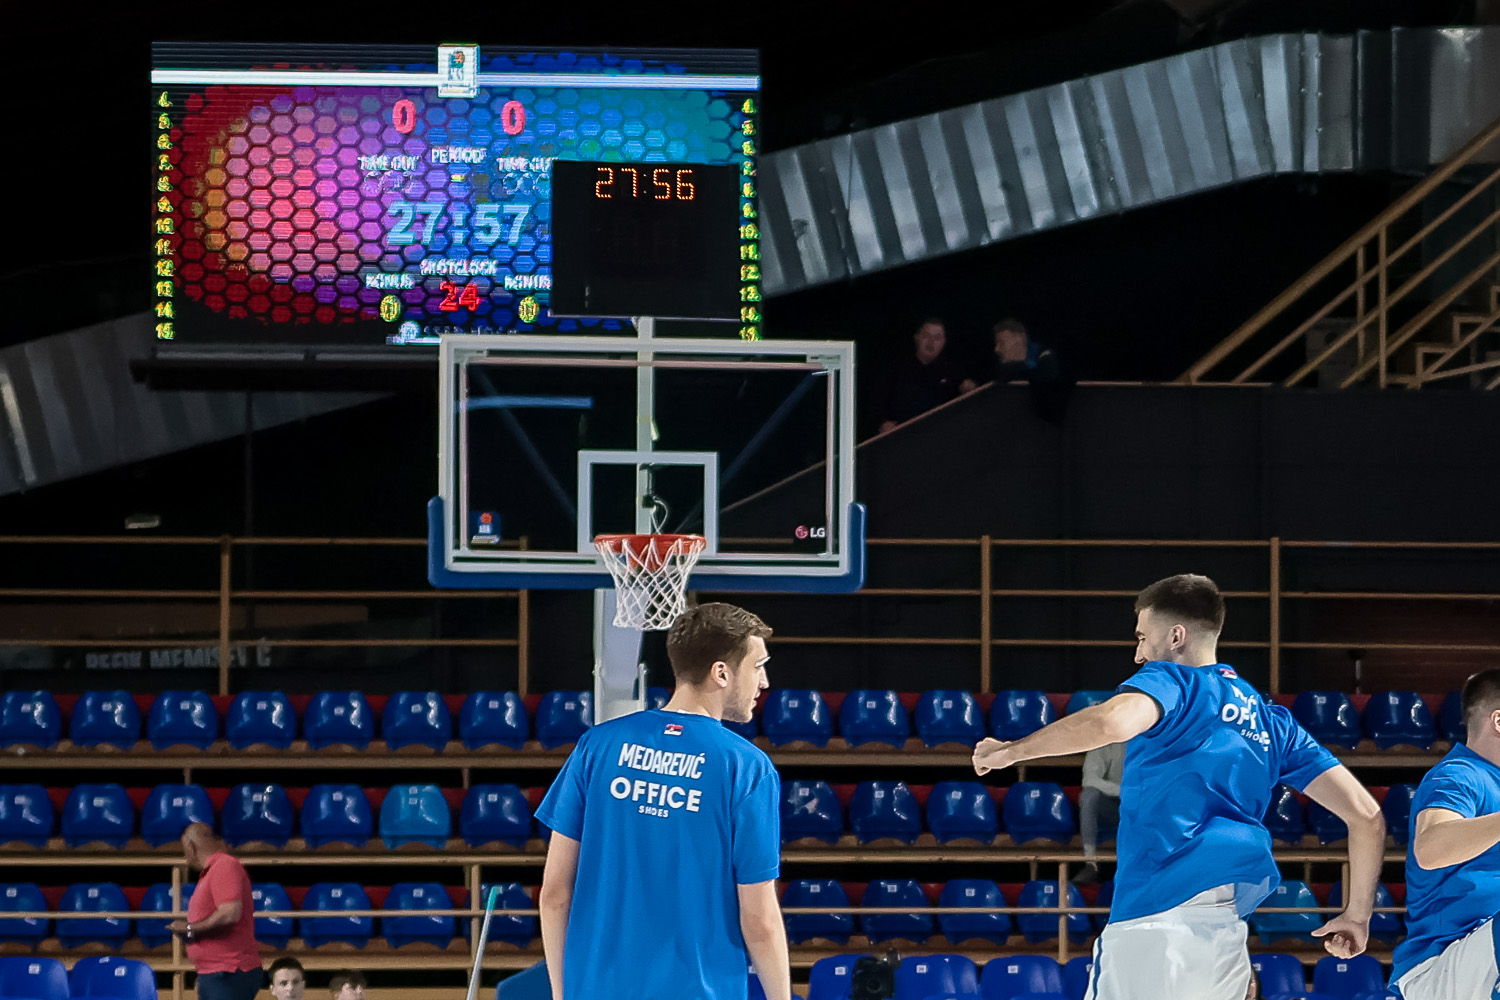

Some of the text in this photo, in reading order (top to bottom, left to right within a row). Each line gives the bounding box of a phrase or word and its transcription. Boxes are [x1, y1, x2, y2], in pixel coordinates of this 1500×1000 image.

[391, 99, 416, 135] 0
[501, 101, 526, 135] 0
[431, 147, 487, 163] PERIOD
[595, 167, 695, 200] 27:56
[387, 201, 532, 246] 27:57
[439, 280, 482, 311] 24
[810, 527, 826, 538] LG
[617, 743, 706, 780] MEDAREVIĆ
[610, 776, 703, 813] OFFICE
[638, 805, 669, 818] SHOES
